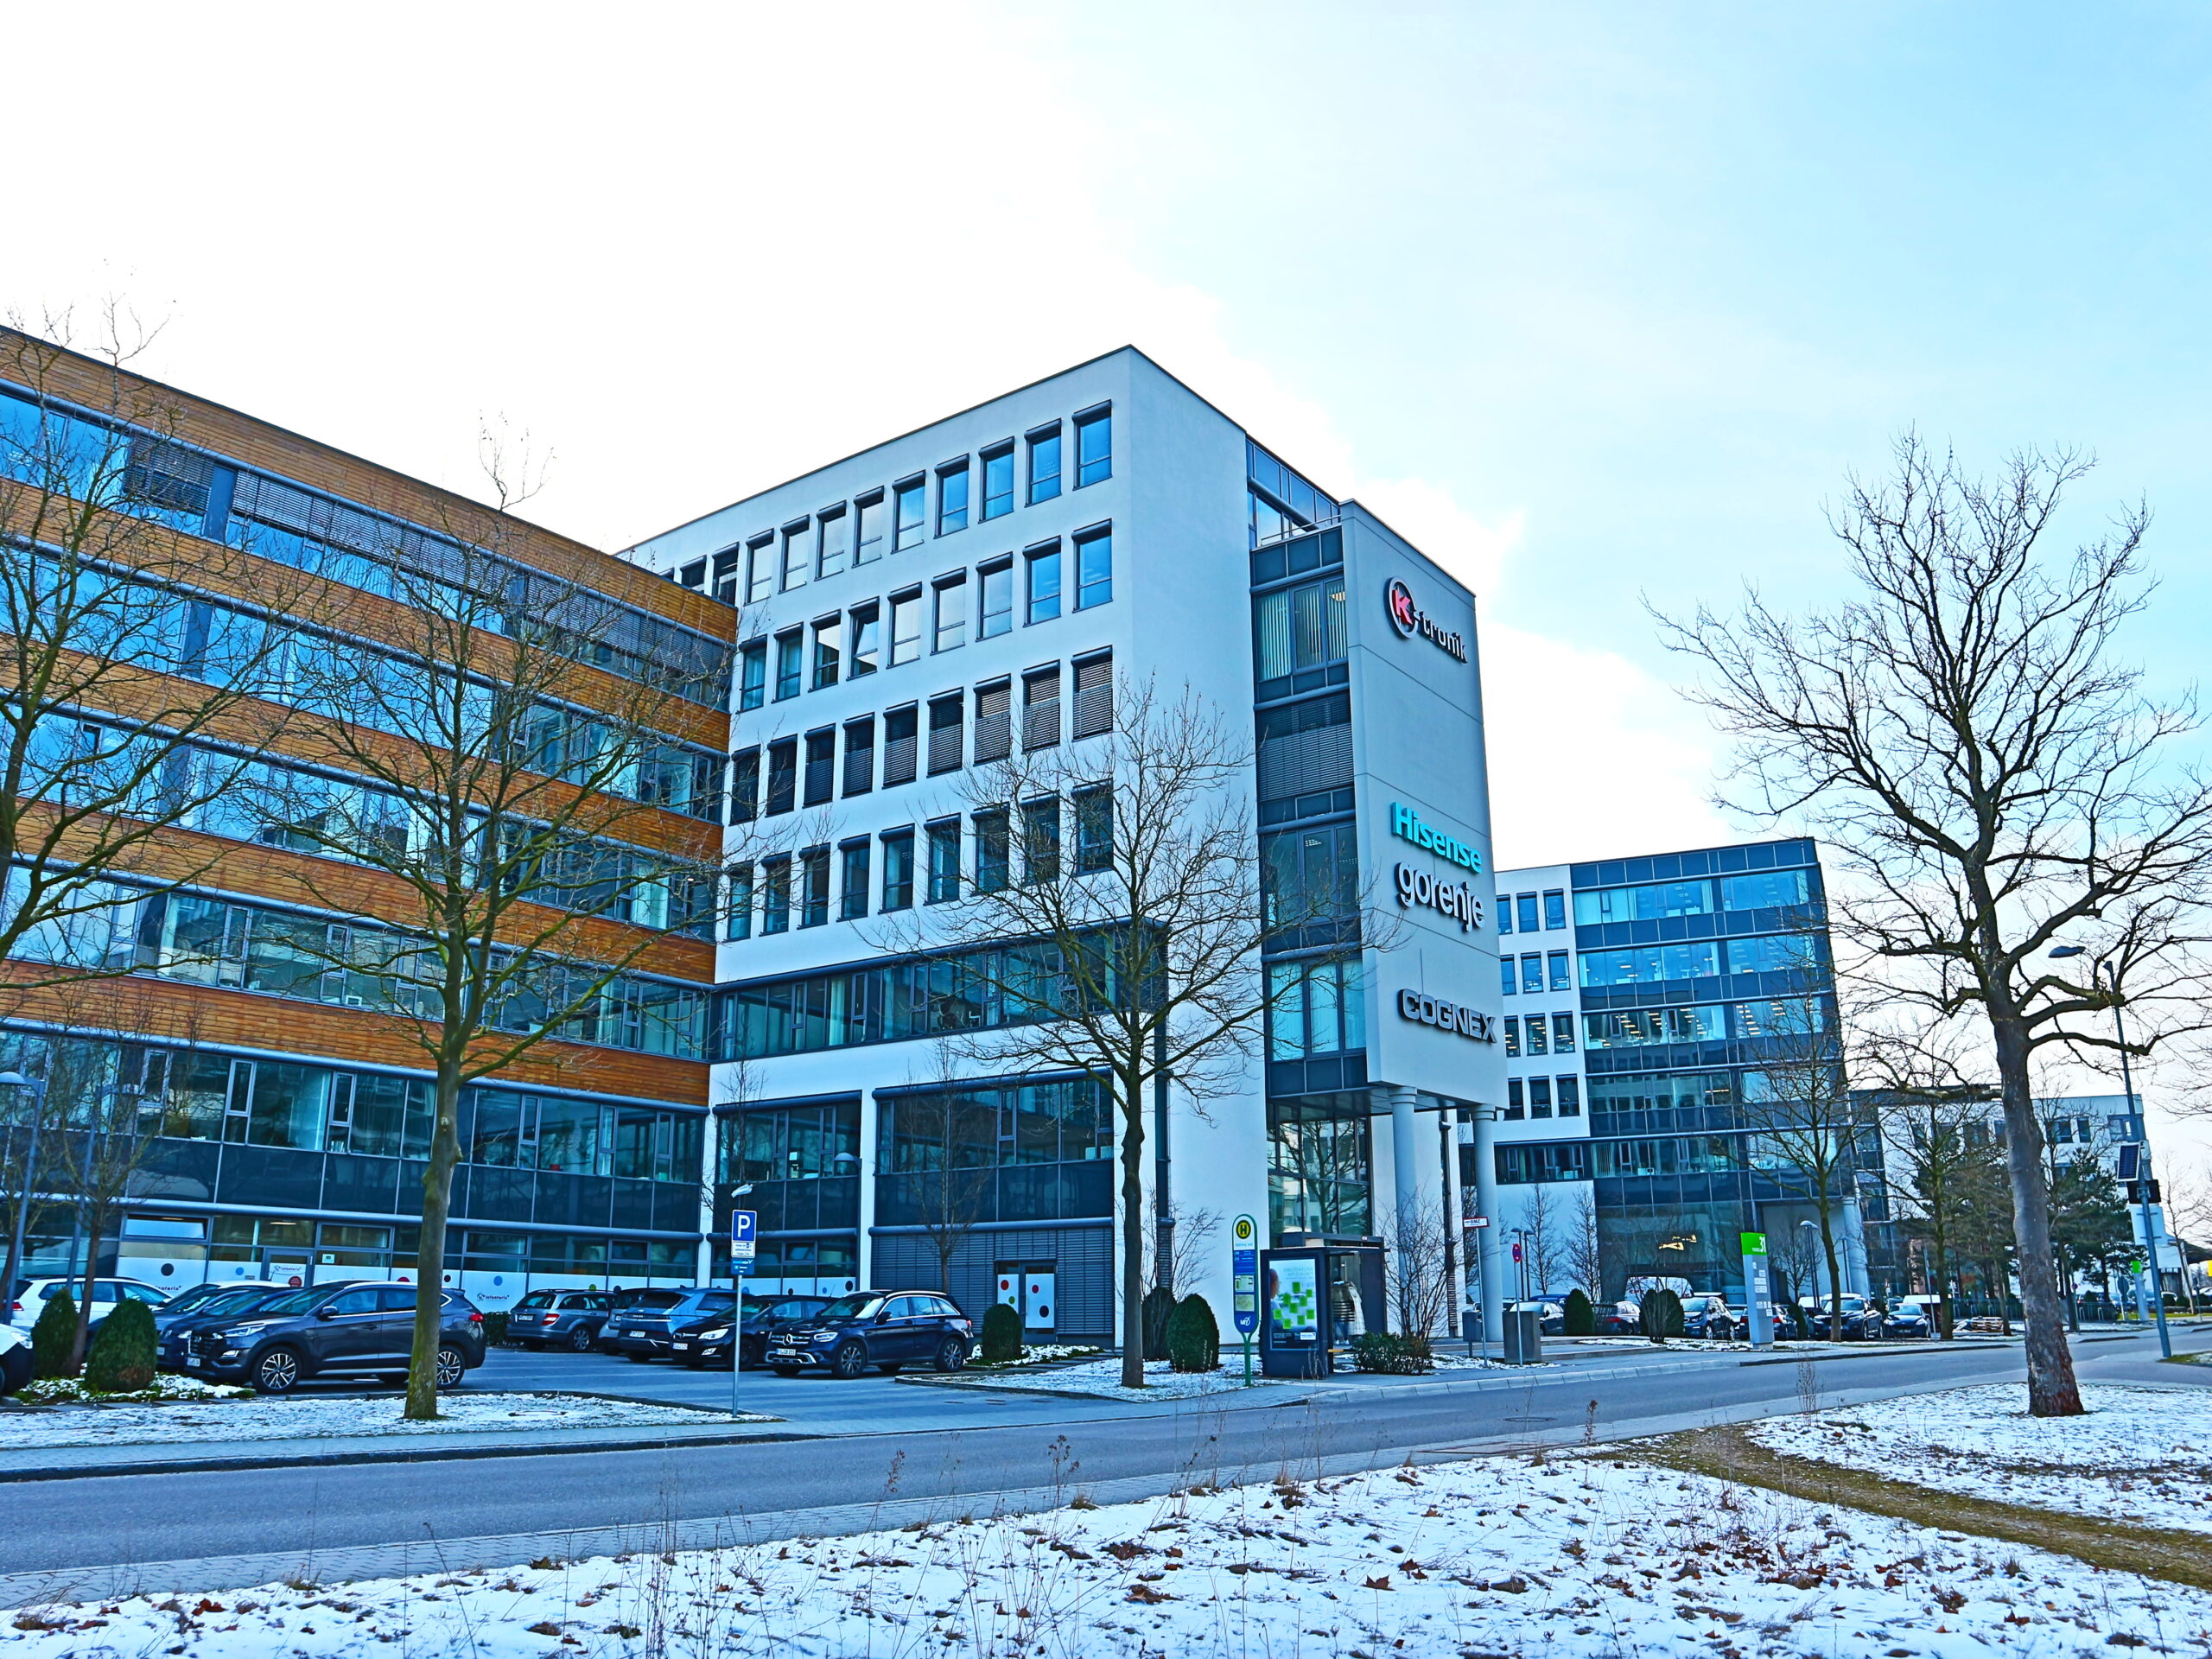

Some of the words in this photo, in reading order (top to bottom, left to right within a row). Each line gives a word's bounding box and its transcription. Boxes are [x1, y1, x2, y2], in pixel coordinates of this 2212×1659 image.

[1390, 802, 1483, 874] Hisense
[1395, 861, 1486, 932] gorenje
[1398, 988, 1497, 1044] COGNEX
[737, 1214, 751, 1238] P
[1240, 1224, 1248, 1236] H
[1758, 1236, 1767, 1253] 31
